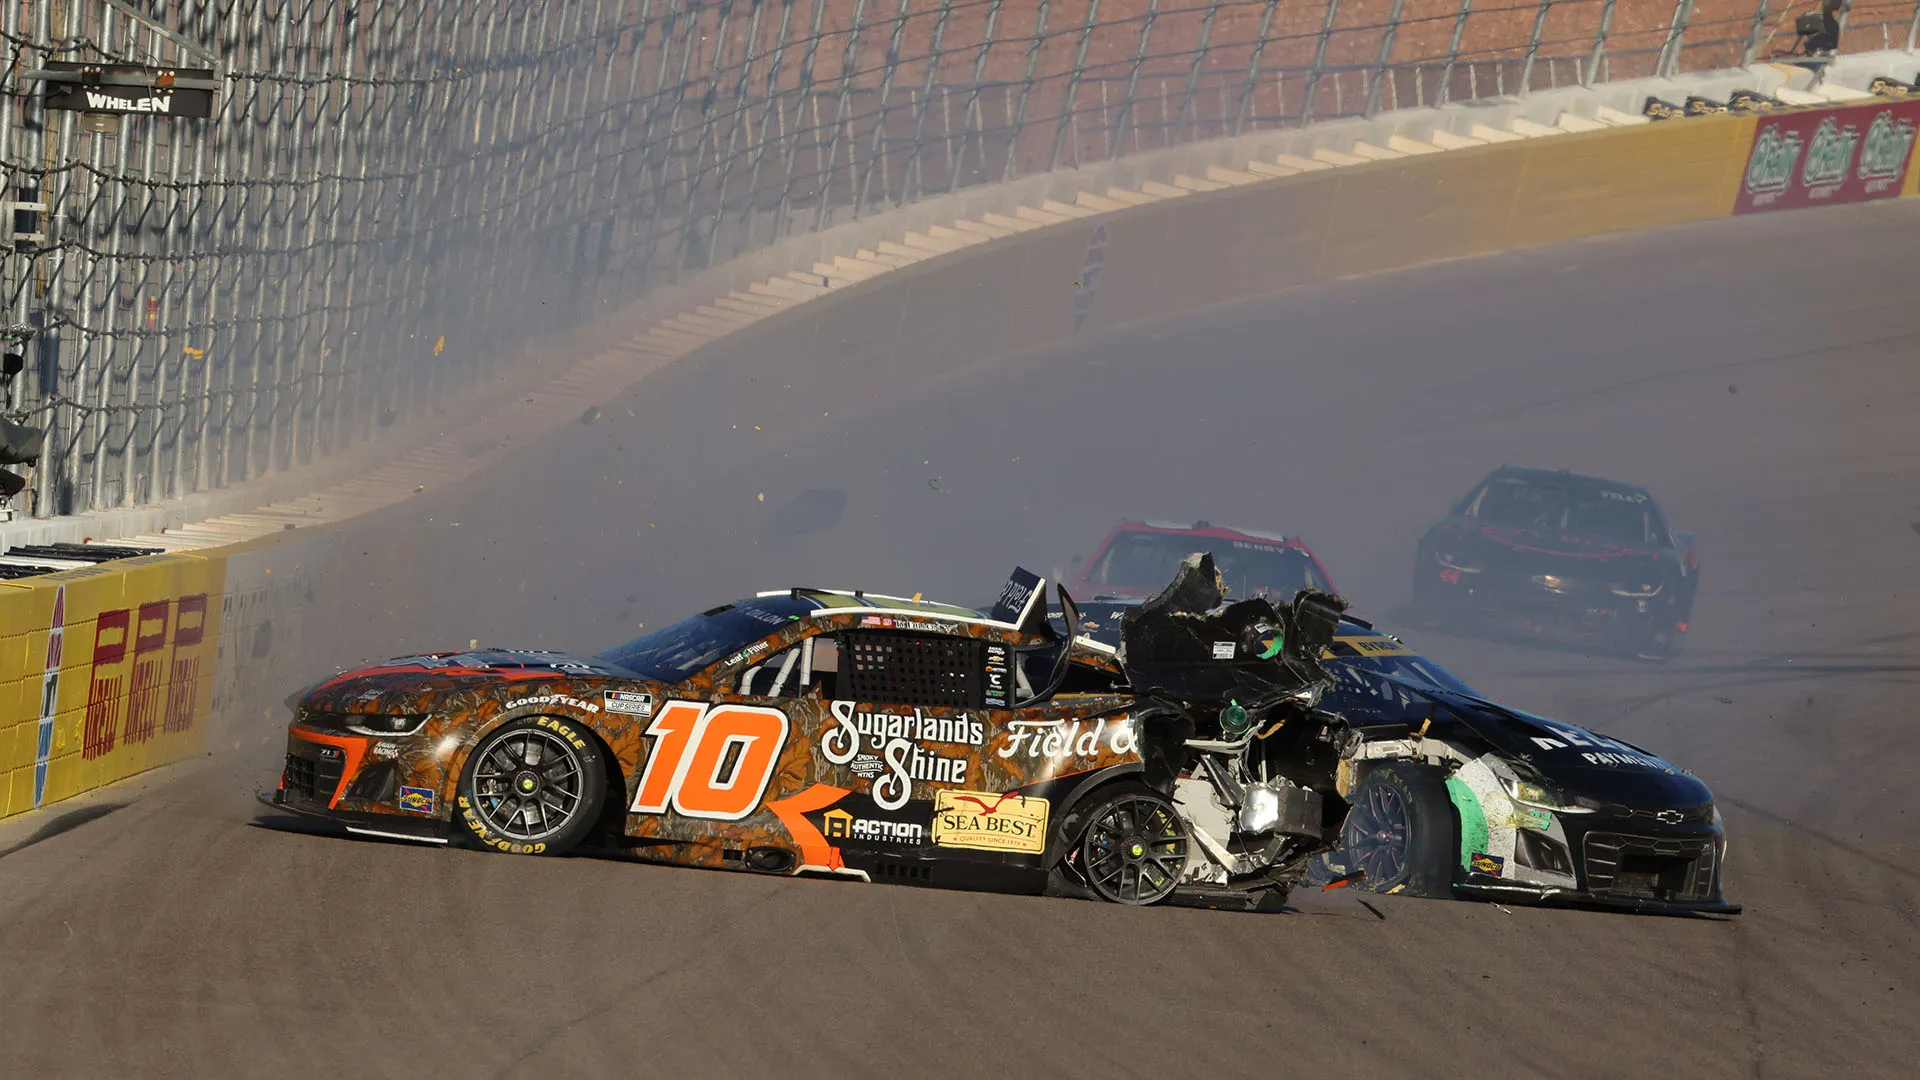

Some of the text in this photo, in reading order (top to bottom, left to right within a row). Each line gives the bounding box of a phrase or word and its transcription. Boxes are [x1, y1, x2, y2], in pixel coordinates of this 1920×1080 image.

[86, 91, 170, 112] WHELEN
[505, 693, 600, 714] GOODYEAR
[618, 694, 646, 703] NASCAR
[625, 703, 646, 712] SERIES
[536, 715, 587, 750] EAGLE
[821, 700, 984, 765] Sugarlands
[998, 717, 1106, 758] Field
[629, 700, 789, 821] 10
[850, 761, 884, 772] AUTHENTIC
[856, 753, 879, 762] SMOKY
[872, 738, 968, 811] Shine
[852, 819, 922, 838] ACTION
[943, 815, 1037, 838] SEA BEST
[853, 833, 922, 845] INDUSTRIES
[1471, 859, 1504, 870] SUNOCO
